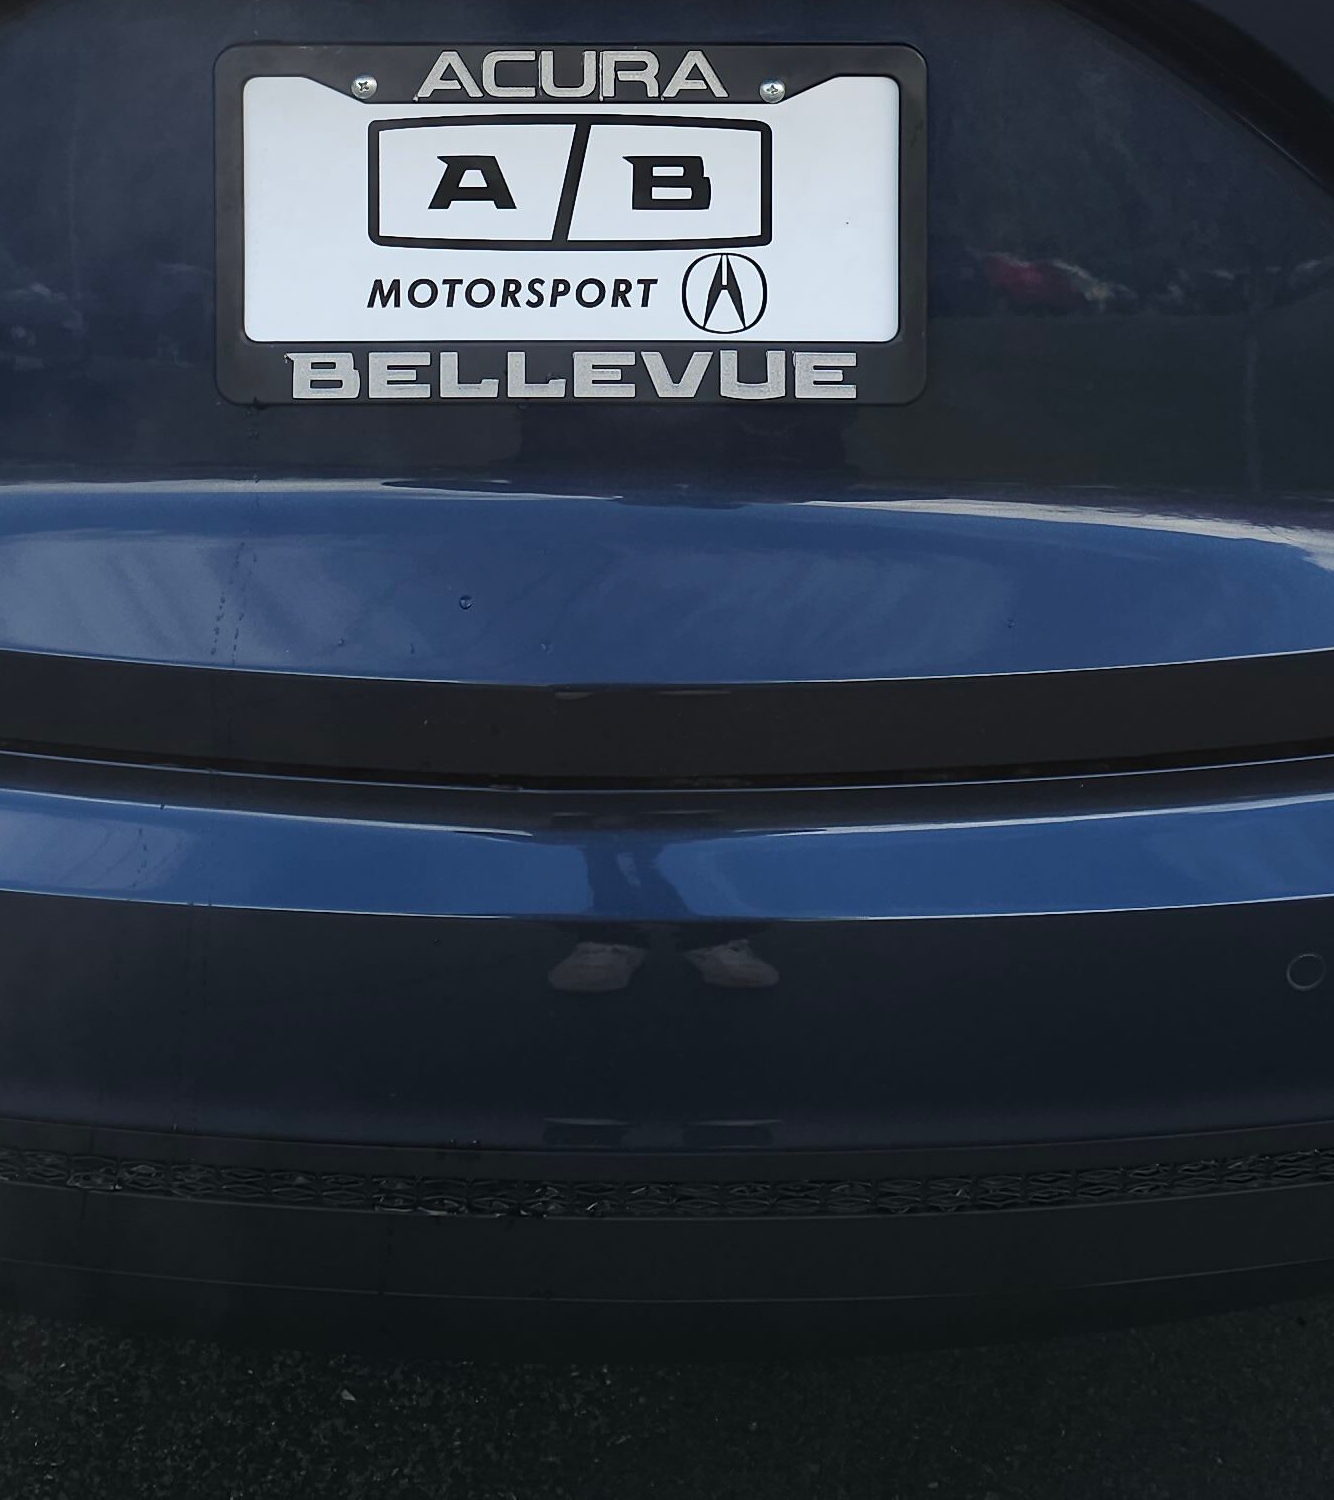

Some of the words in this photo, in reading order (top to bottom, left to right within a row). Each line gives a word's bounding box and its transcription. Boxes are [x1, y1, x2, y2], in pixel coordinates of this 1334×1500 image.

[414, 50, 728, 100] ACURA
[367, 278, 658, 309] MOTORSPORT
[285, 351, 857, 399] BELLEVUE
